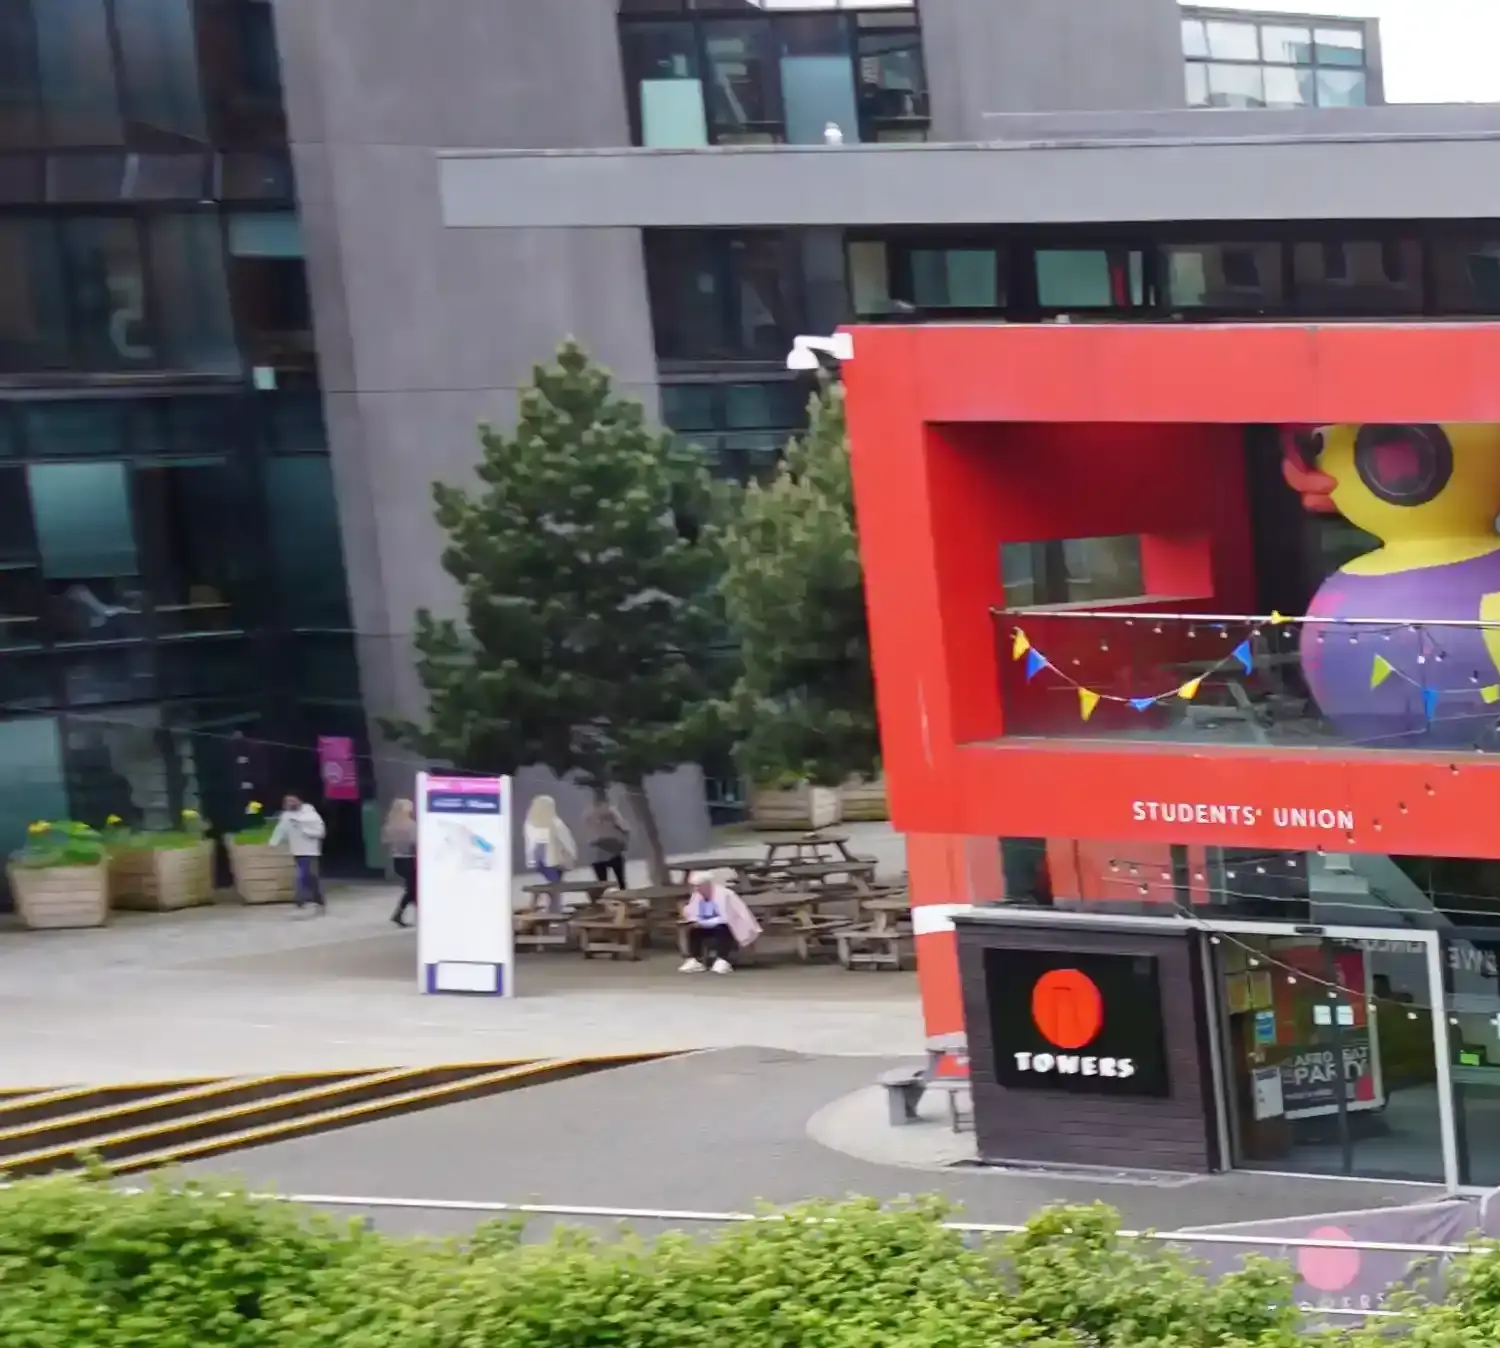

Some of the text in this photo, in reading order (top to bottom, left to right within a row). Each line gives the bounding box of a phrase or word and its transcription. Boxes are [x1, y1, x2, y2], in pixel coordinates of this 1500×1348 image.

[1132, 801, 1354, 830] STUDENTS' UNION
[1014, 1052, 1135, 1078] TOWERS
